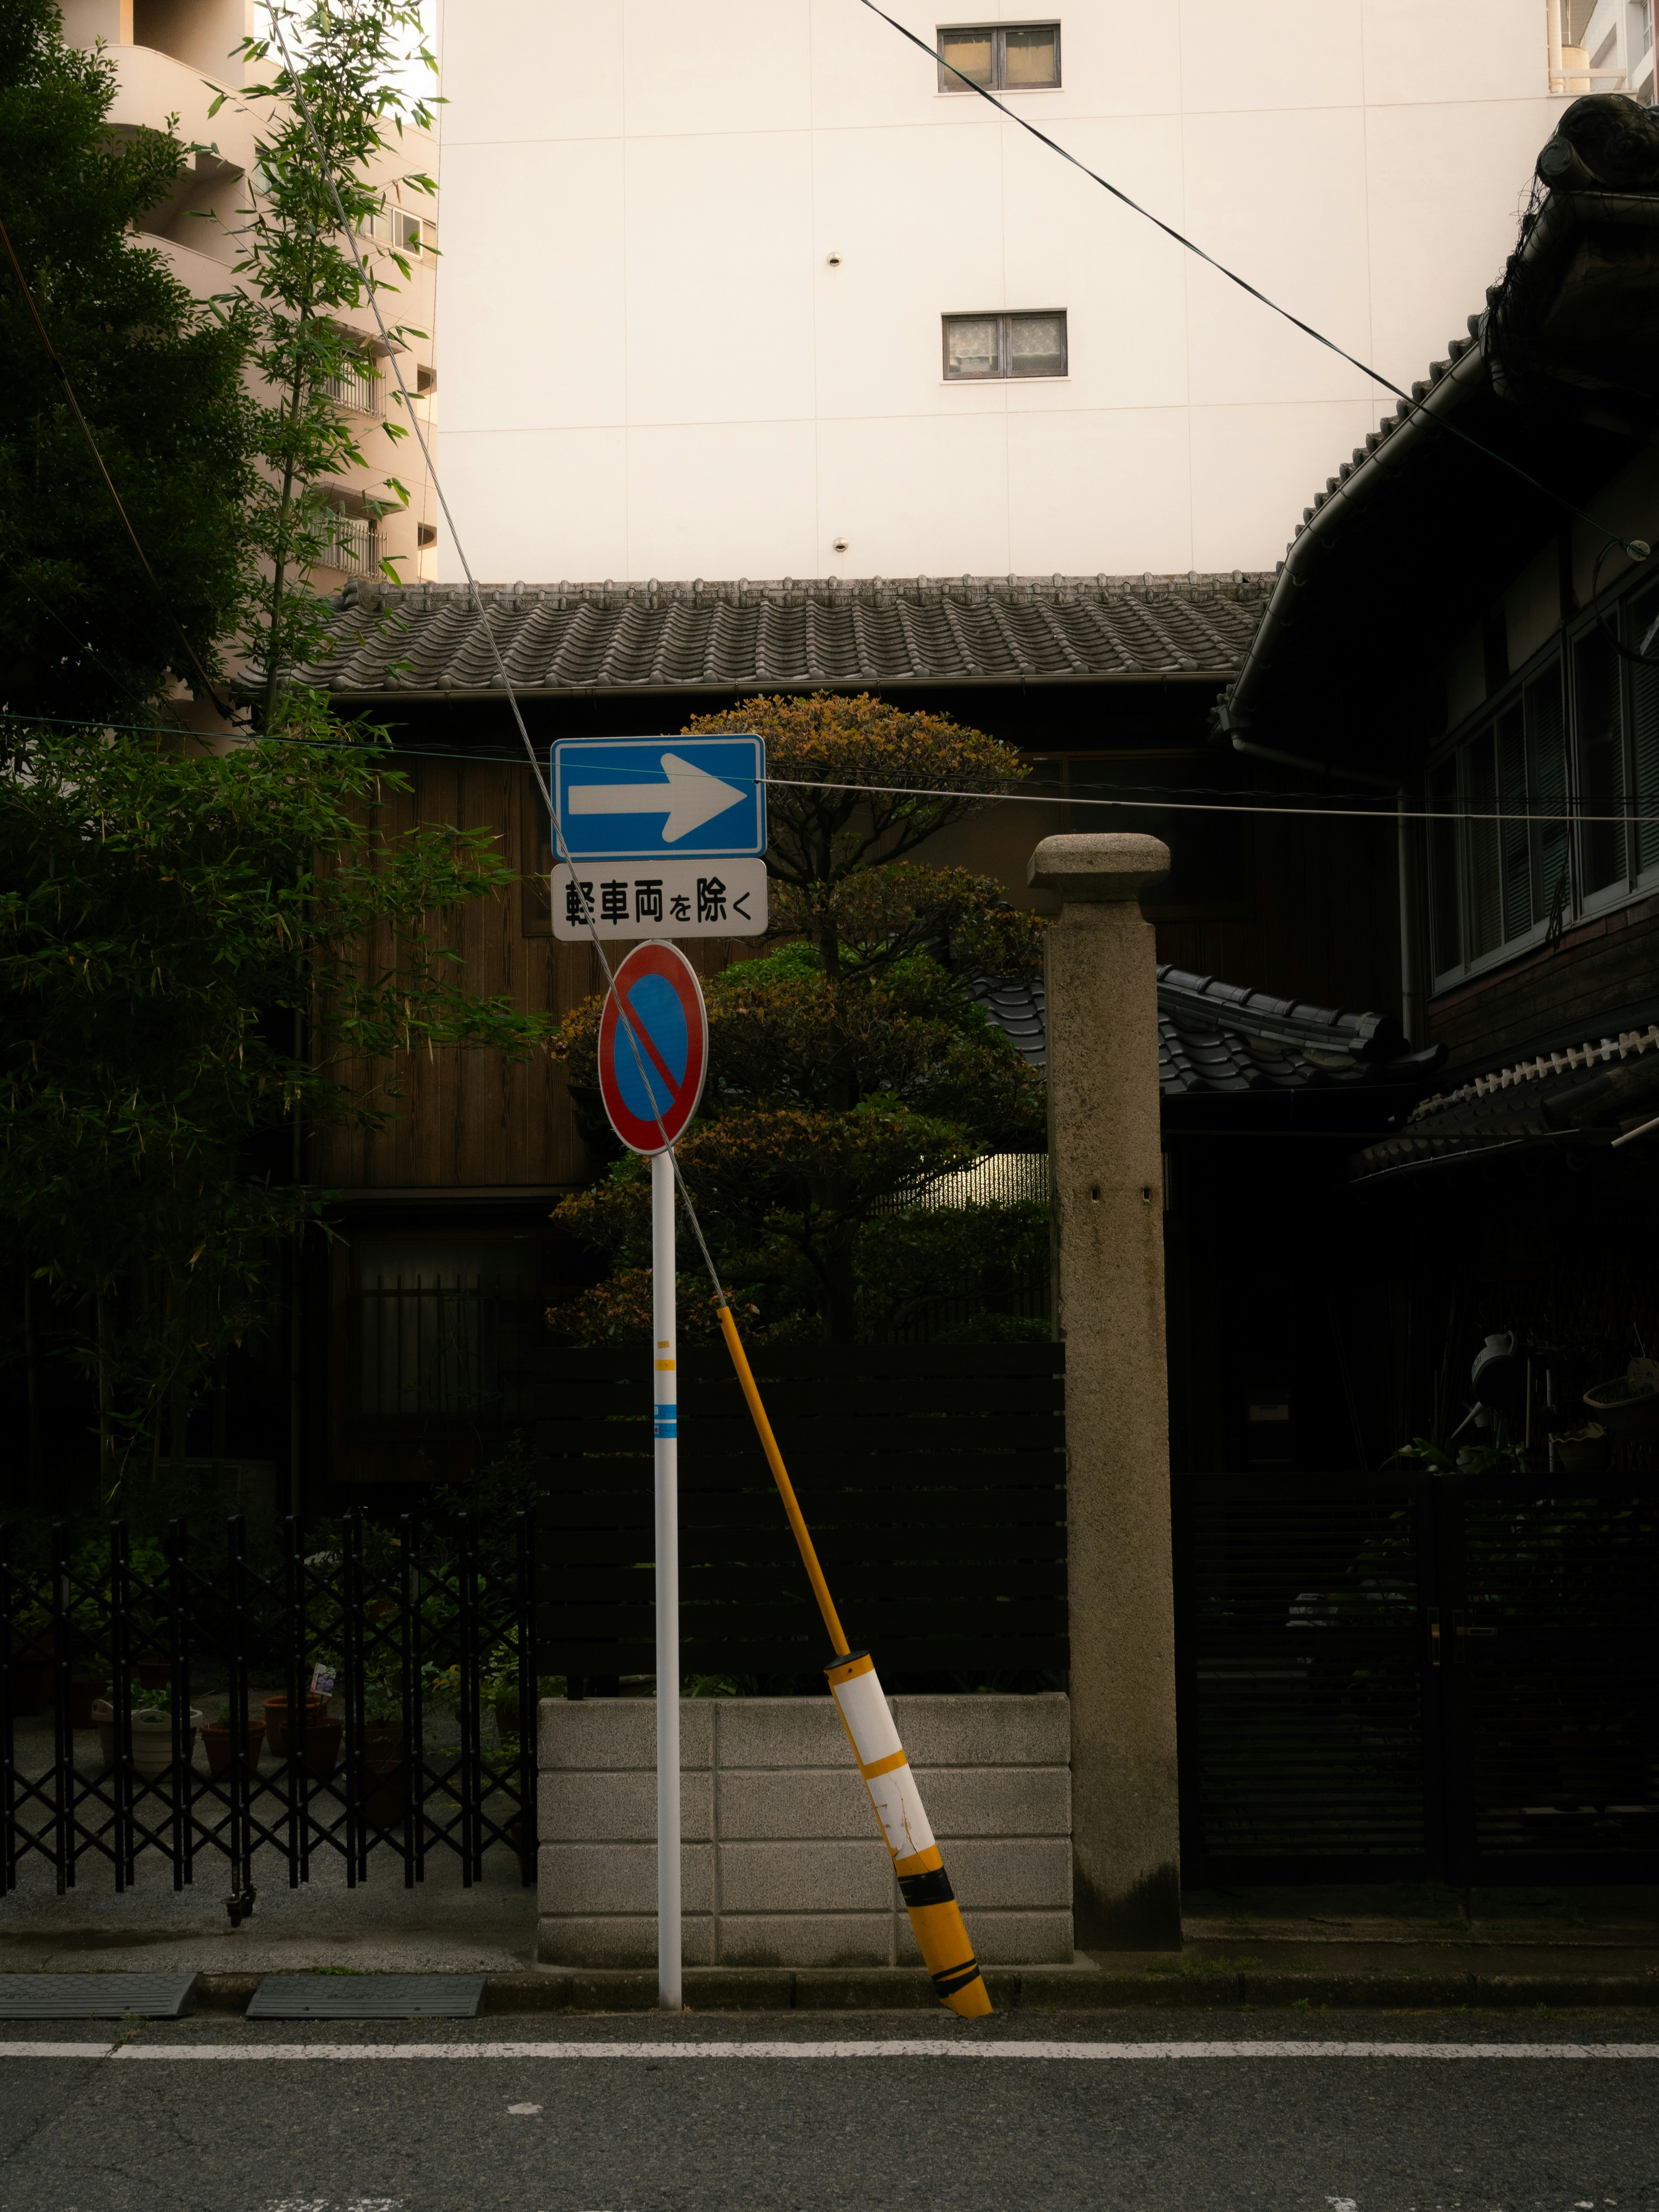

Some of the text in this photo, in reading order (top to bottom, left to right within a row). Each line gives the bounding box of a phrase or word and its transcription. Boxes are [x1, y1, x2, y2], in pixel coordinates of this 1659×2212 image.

[565, 877, 751, 927] 軽車両を除く
